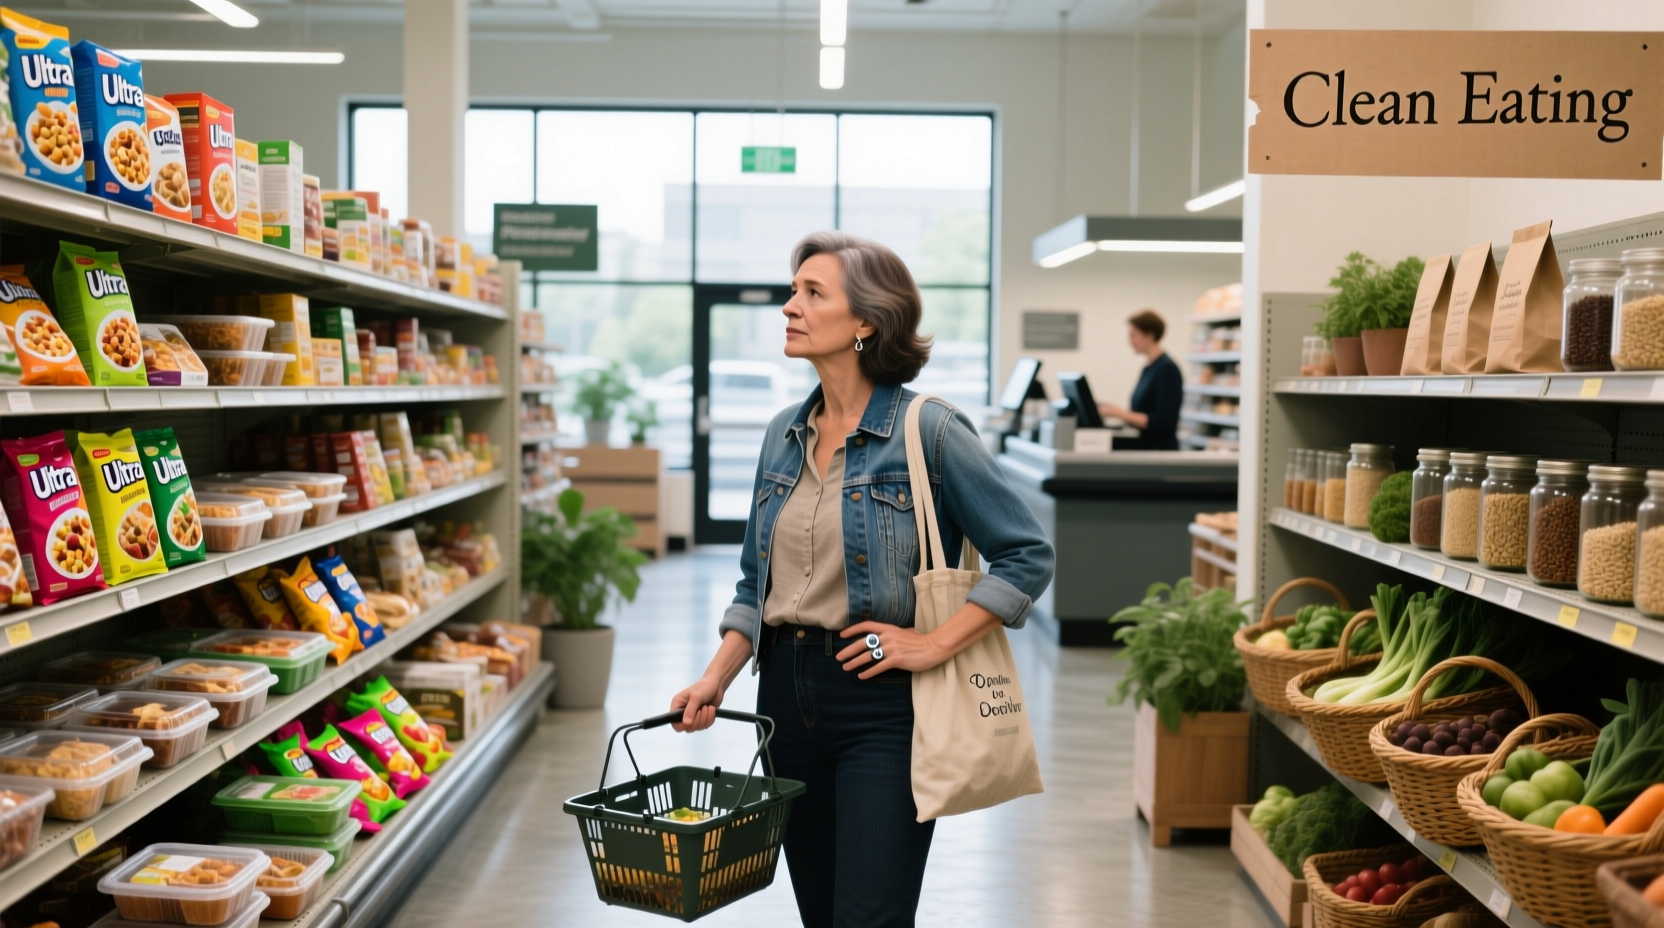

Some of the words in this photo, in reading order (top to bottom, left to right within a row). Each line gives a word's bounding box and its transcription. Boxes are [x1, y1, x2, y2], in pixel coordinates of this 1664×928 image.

[21, 54, 74, 89] Ultra
[102, 73, 144, 106] Ultra
[1283, 69, 1438, 128] Clean
[1457, 70, 1634, 143] Eating
[29, 465, 78, 499] Ultra
